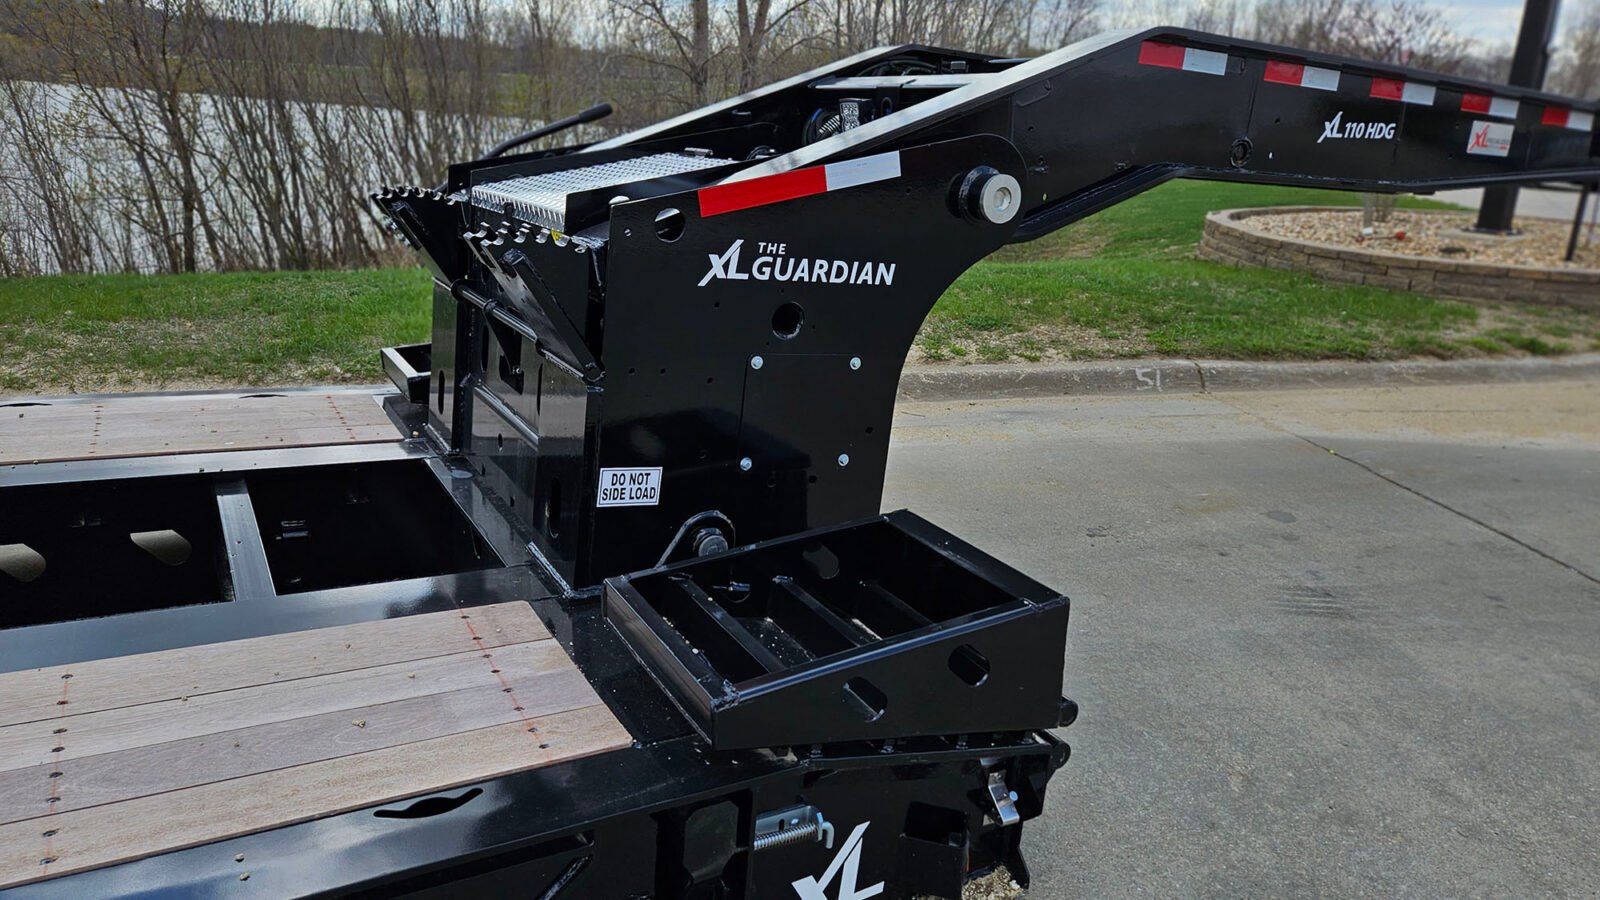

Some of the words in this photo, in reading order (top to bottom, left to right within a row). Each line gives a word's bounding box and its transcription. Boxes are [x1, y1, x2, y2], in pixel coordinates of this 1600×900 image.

[1317, 111, 1343, 143] XL
[1343, 122, 1365, 139] 110
[1364, 122, 1396, 140] HDG
[1469, 124, 1489, 152] XL
[758, 242, 787, 255] THE
[697, 239, 749, 287] XL
[751, 256, 896, 286] GUARDIAN
[611, 473, 626, 486] DO
[629, 472, 651, 485] NOT
[602, 487, 626, 501] SIDE
[629, 486, 656, 500] LOAD
